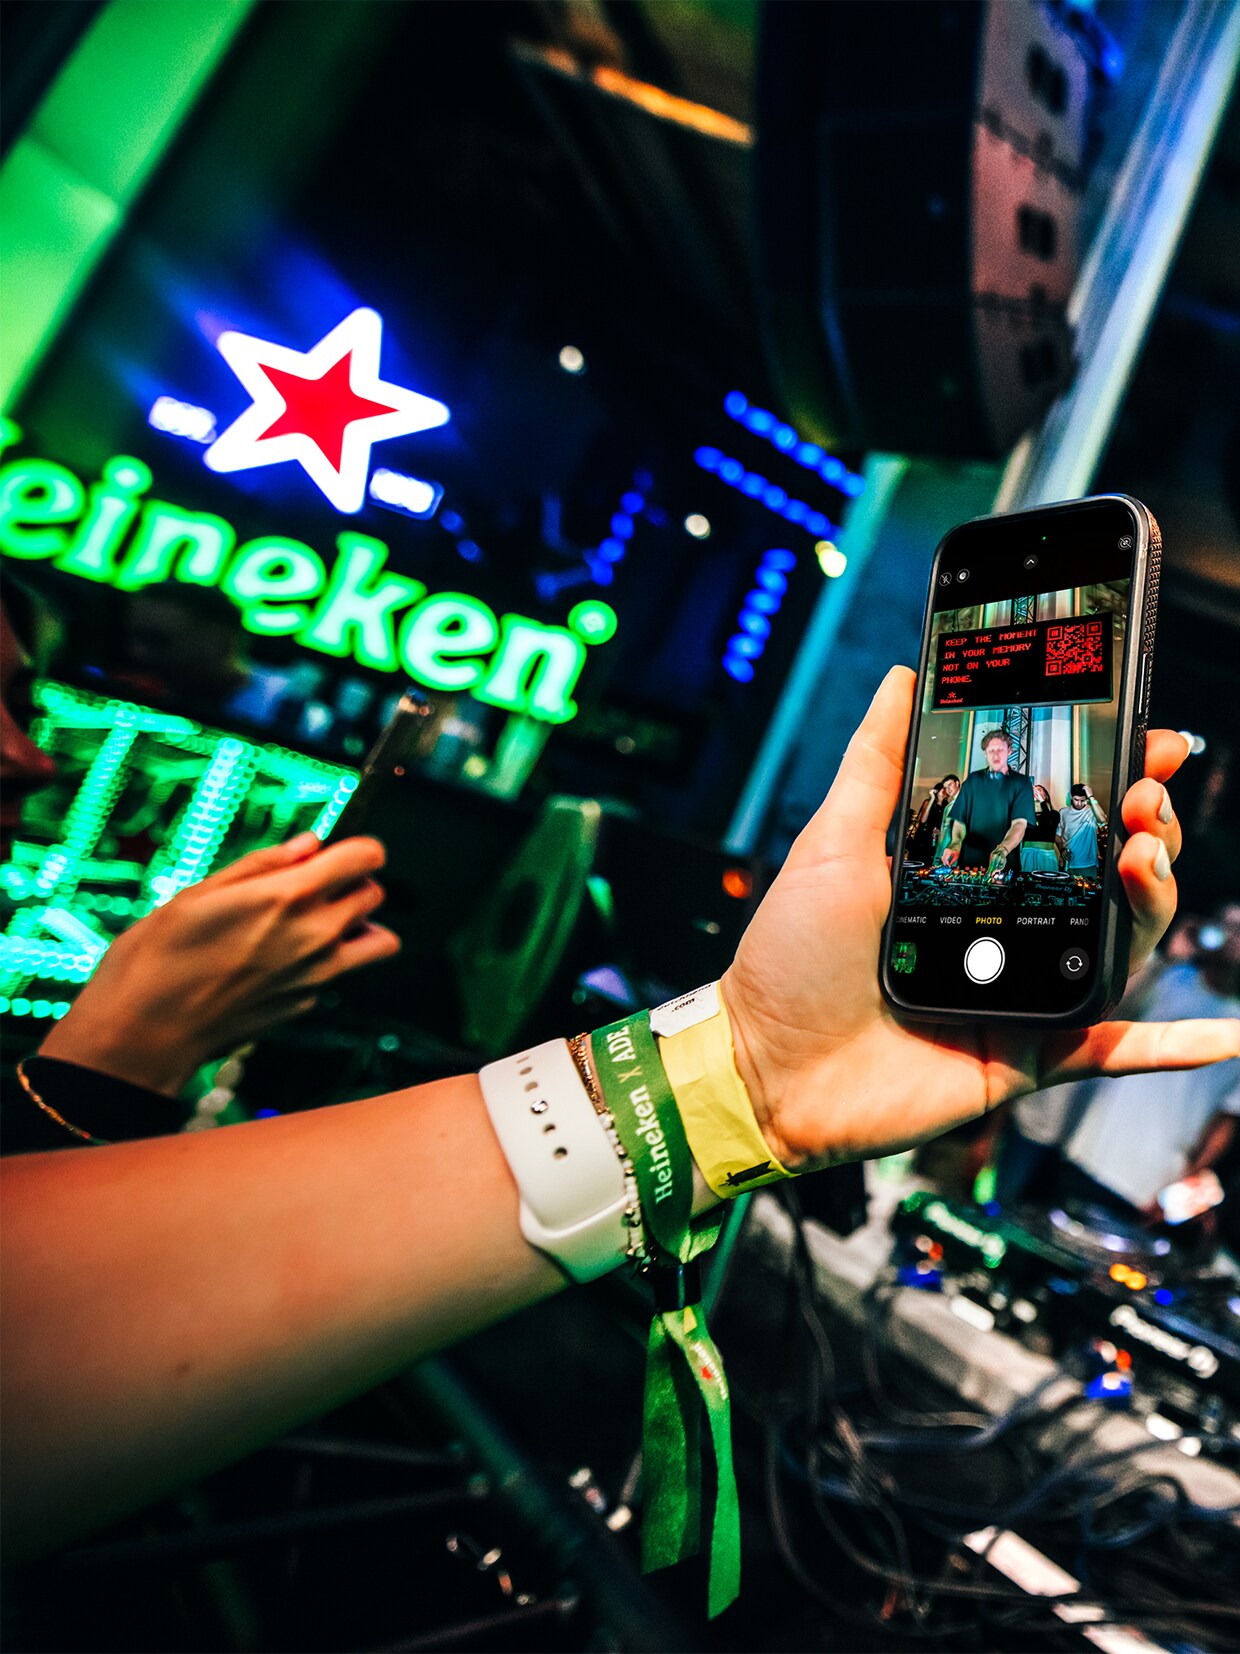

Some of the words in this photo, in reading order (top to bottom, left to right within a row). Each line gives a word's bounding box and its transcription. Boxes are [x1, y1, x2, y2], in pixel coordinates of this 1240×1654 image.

[0, 416, 618, 724] eineken
[945, 637, 968, 647] KEEP
[974, 634, 992, 644] THE
[999, 629, 1038, 641] MOMENT
[944, 651, 956, 659] IN
[962, 648, 986, 658] YOUR
[992, 643, 1032, 655] MEMORY
[942, 663, 960, 672] NOT
[966, 661, 979, 670] ON
[986, 658, 1011, 668] YOUR
[939, 916, 962, 925] VIDEO
[975, 916, 1003, 925] PHOTO
[1016, 917, 1056, 926] PORTRAIT
[606, 1025, 636, 1063] ADE
[629, 1085, 674, 1206] Heineken
